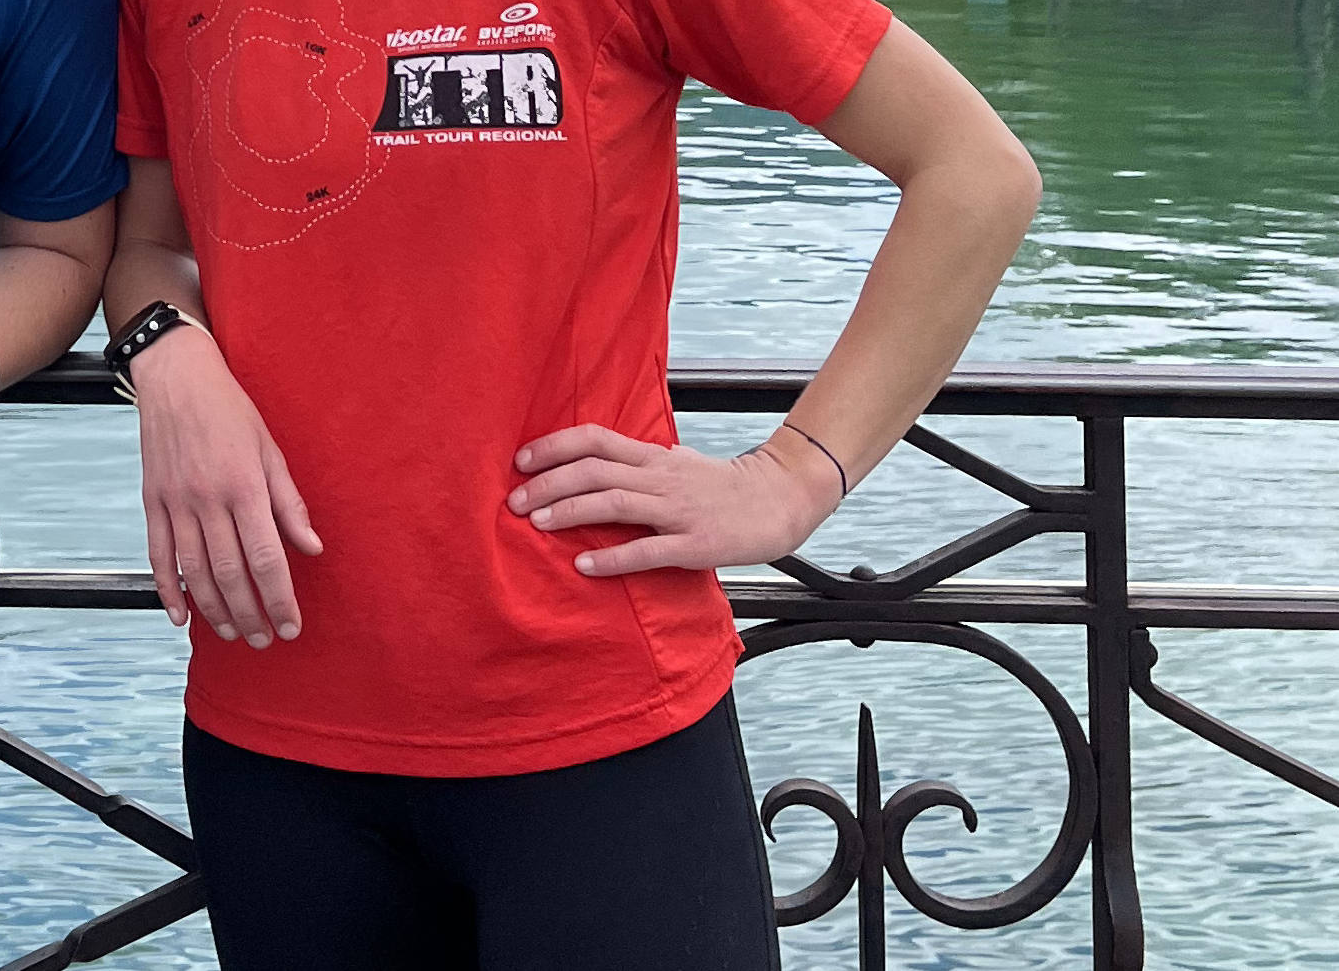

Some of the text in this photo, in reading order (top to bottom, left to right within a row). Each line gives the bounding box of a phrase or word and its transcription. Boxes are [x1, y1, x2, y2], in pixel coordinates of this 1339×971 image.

[373, 130, 568, 146] TRAIL TOUR REGIONAL
